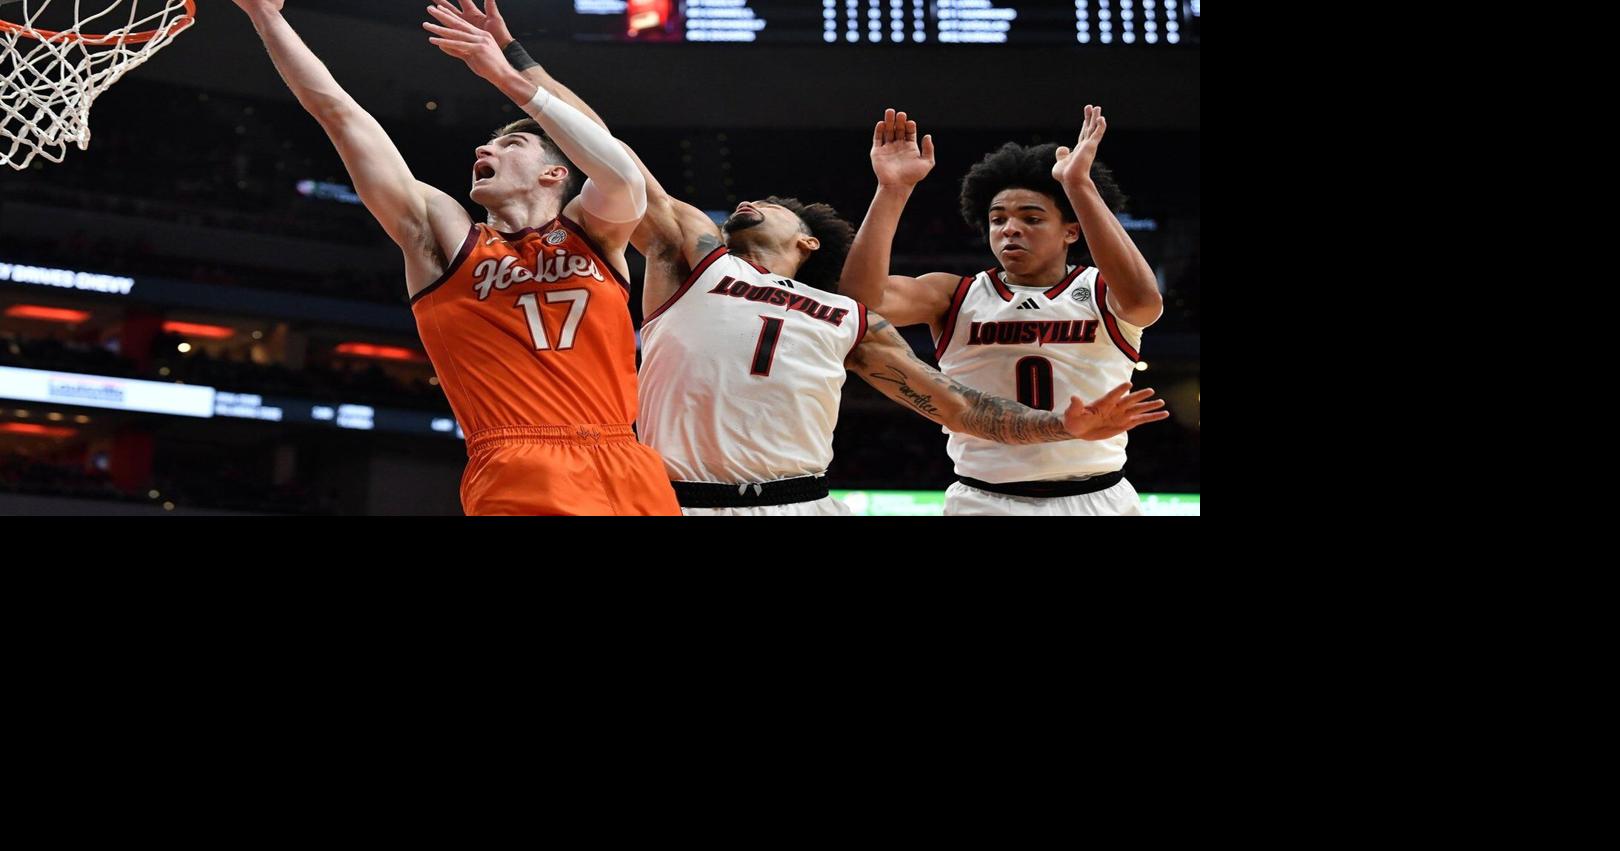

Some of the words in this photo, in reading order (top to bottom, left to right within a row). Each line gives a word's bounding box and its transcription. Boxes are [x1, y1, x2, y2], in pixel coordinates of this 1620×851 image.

[472, 249, 606, 300] Hokies
[706, 275, 850, 327] LOUISVILLE
[513, 288, 591, 351] 17
[750, 315, 784, 377] 1
[967, 319, 1100, 347] LOUISVILLE
[1016, 355, 1055, 411] 0
